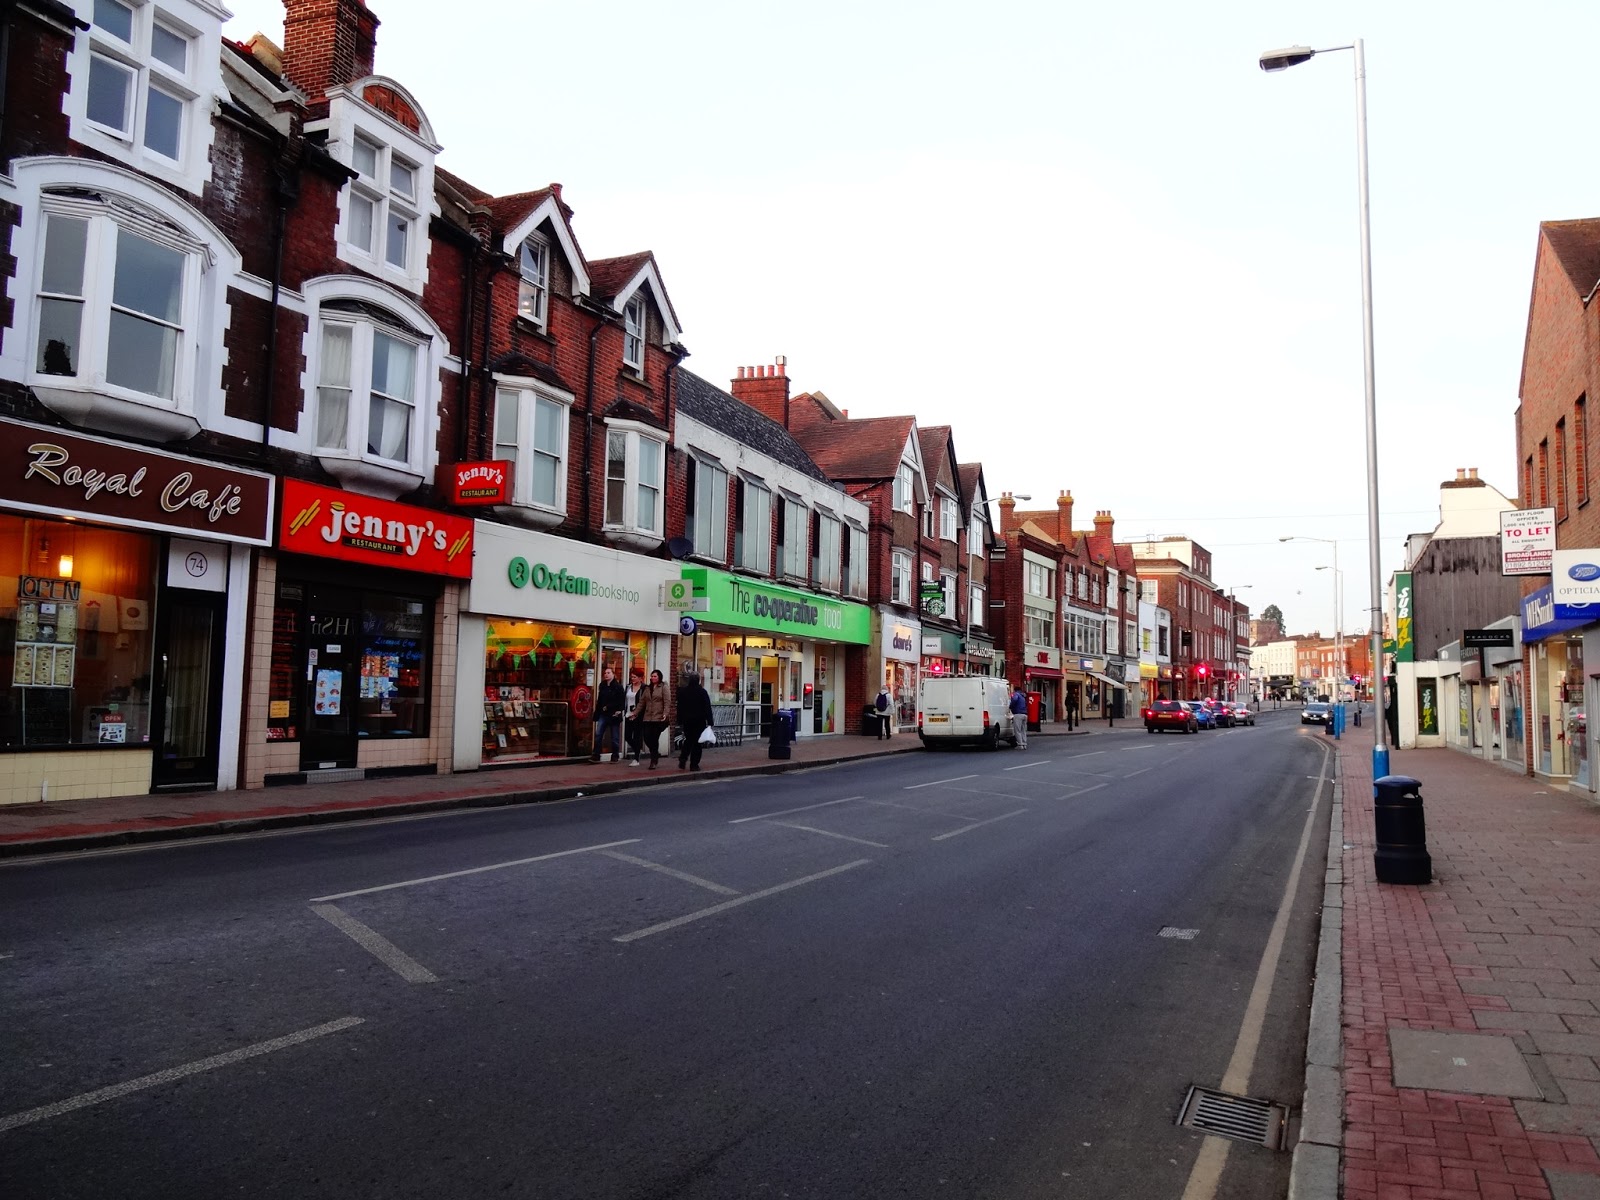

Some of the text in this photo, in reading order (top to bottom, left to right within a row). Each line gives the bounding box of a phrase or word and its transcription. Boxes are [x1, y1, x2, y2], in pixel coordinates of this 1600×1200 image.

[24, 443, 242, 522] Royal Café
[458, 466, 503, 486] Jenny's
[461, 489, 498, 497] RESTAURANT
[1505, 526, 1551, 537] TO LET
[351, 538, 397, 552] RESTAURANT
[1506, 551, 1552, 559] BROADLANDS
[190, 557, 204, 571] 74
[23, 576, 80, 600] OPEN
[532, 563, 640, 605] Oxfam Bookshop
[667, 600, 689, 608] Oxfam
[729, 581, 842, 630] The co-operative food
[1397, 587, 1412, 649] SUBWAY
[1422, 689, 1433, 729] SUBWAY
